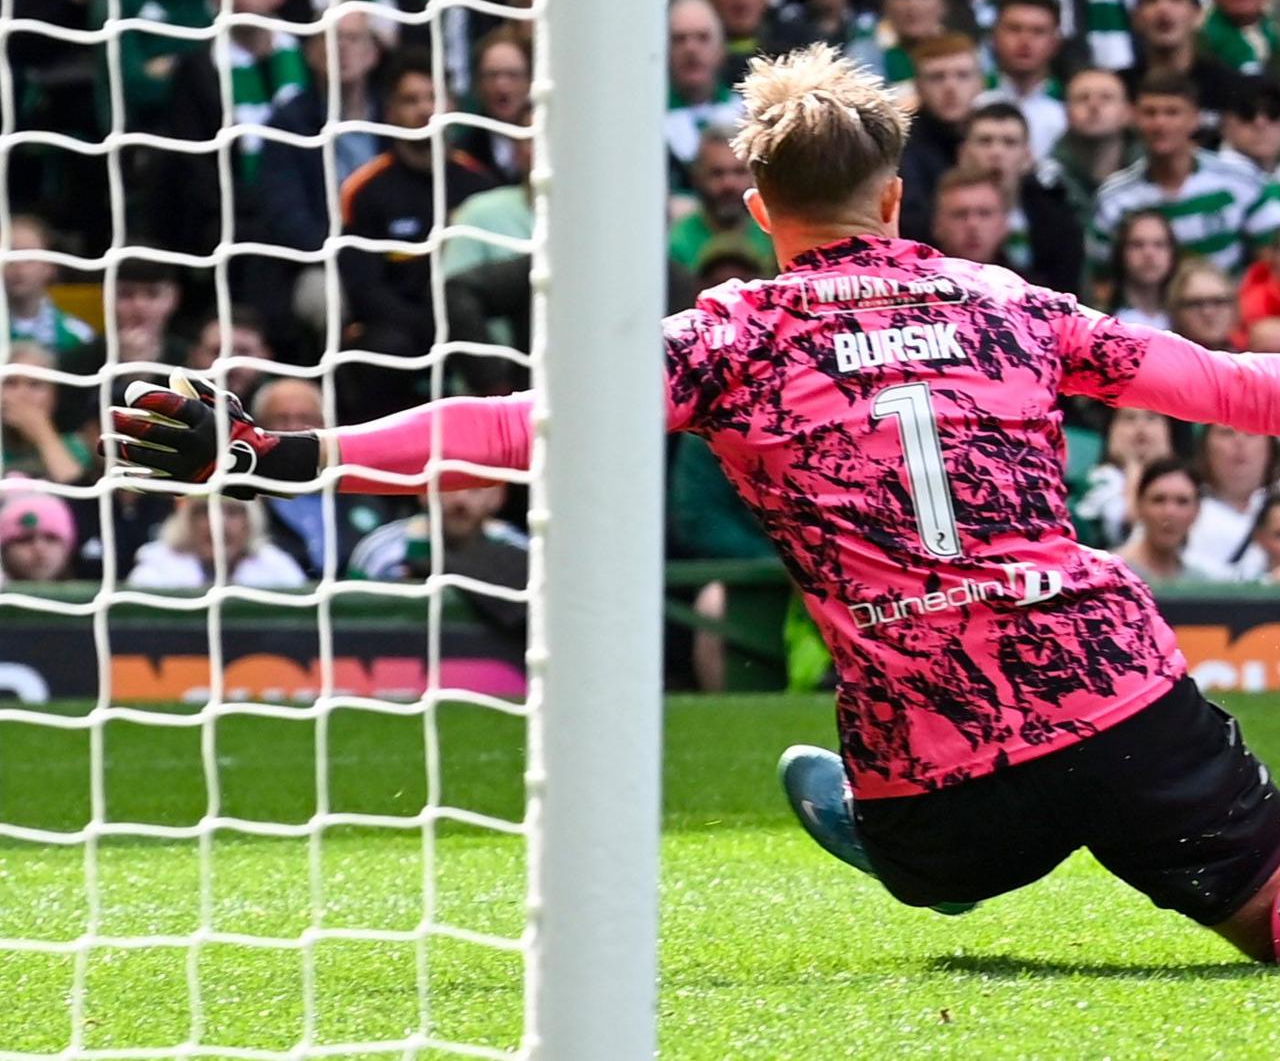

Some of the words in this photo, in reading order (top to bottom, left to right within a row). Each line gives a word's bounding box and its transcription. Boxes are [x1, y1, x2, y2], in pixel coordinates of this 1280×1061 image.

[811, 275, 899, 303] WHISKY
[833, 323, 966, 373] BURSIK
[873, 381, 962, 559] 1
[848, 578, 1004, 629] Dunedin
